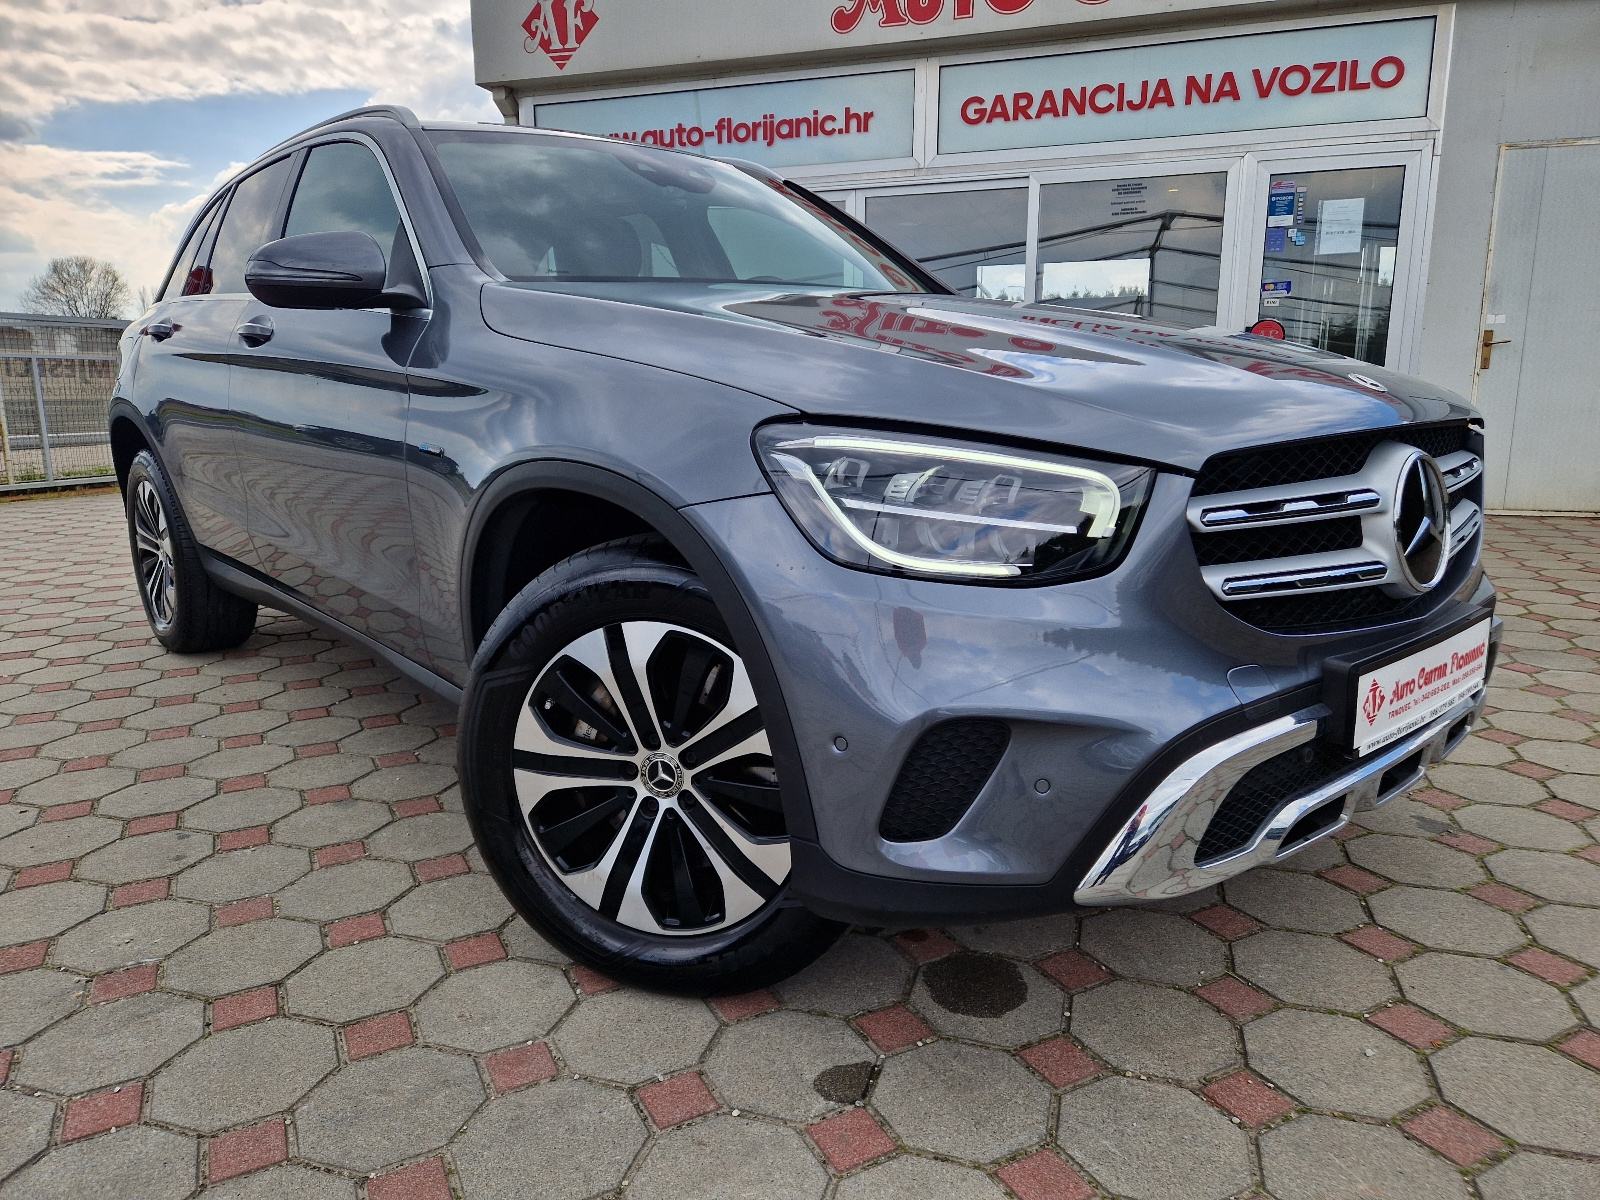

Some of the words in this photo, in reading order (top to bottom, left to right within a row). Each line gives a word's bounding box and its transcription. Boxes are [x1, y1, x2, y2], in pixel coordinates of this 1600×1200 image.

[960, 77, 1175, 125] GARANCIJA
[1184, 71, 1241, 105] NA
[1251, 55, 1405, 99] VOZILO
[608, 107, 874, 148] auto-florijanic.hr
